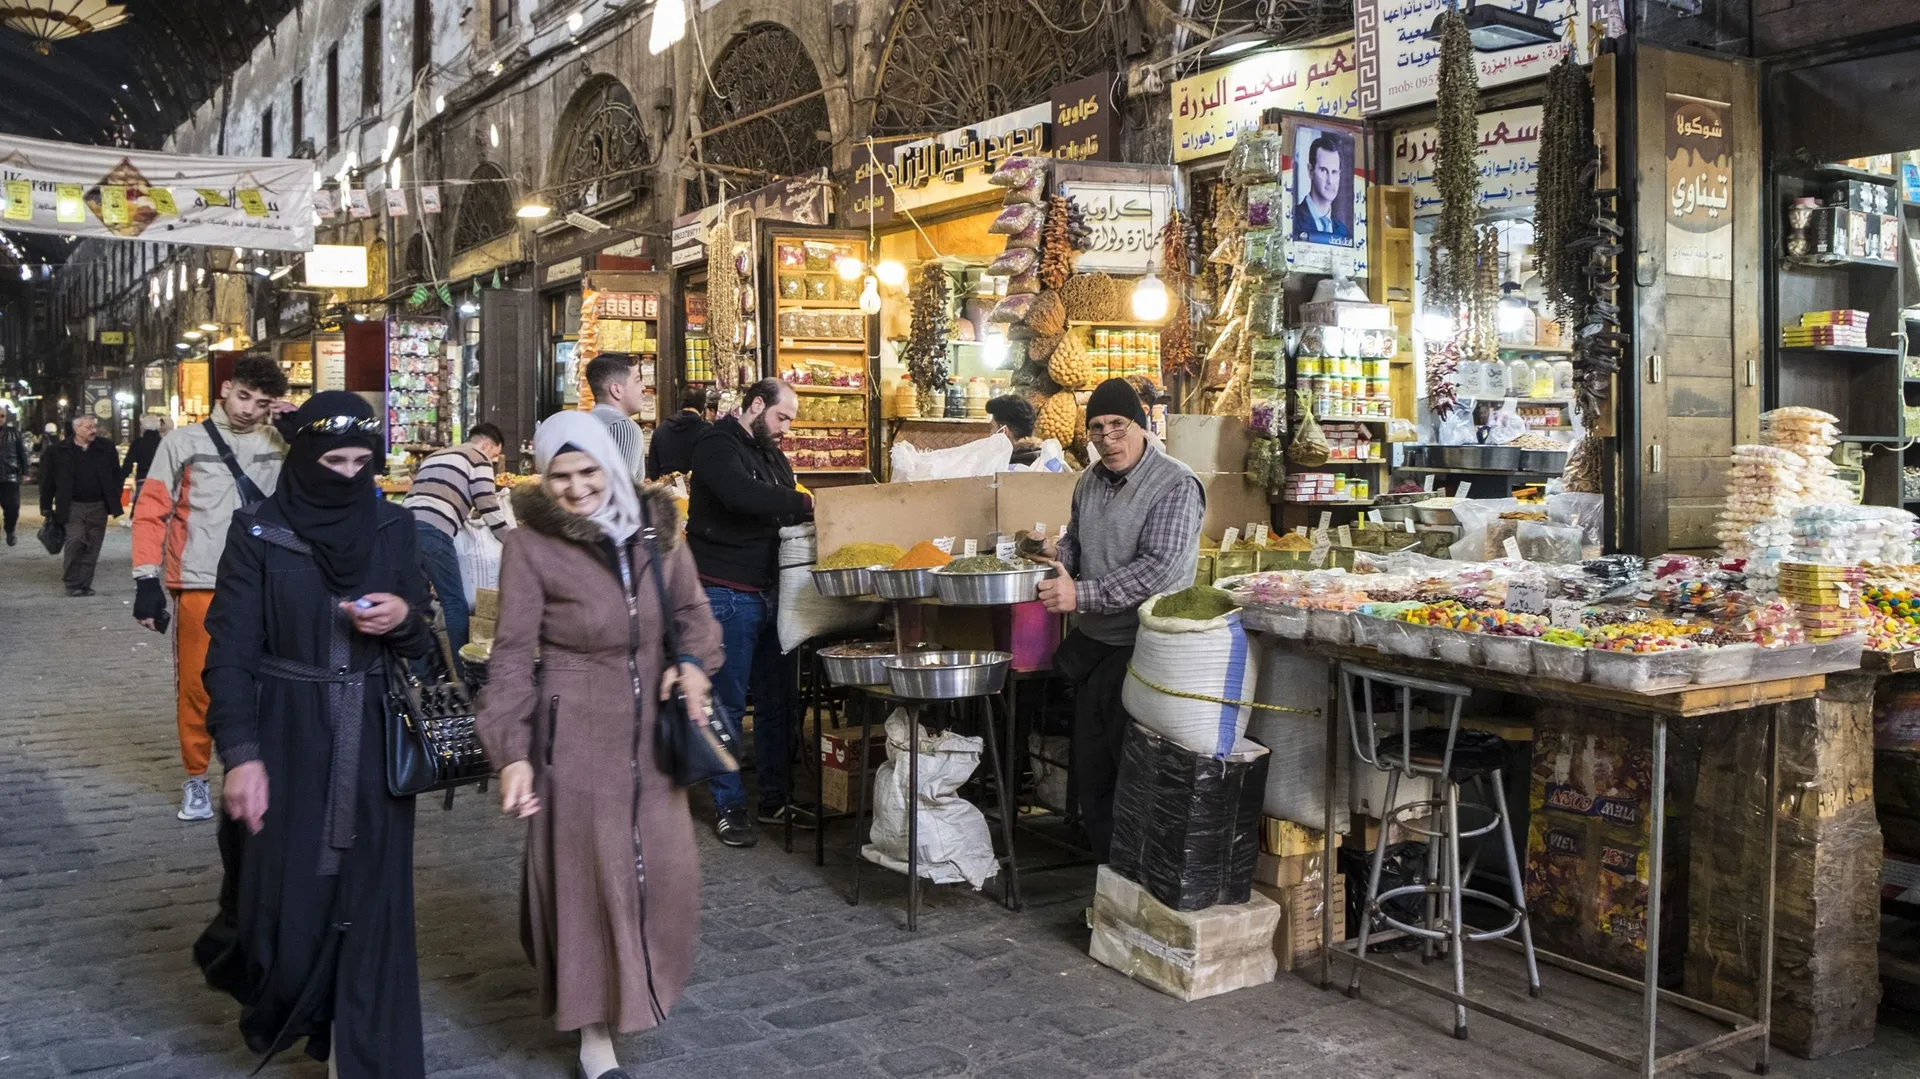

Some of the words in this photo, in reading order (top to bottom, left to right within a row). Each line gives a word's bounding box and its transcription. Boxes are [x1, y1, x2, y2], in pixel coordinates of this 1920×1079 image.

[1305, 43, 1357, 91] نعيم
[1480, 56, 1512, 75] البزرة
[1514, 52, 1540, 69] سعيد
[1180, 77, 1227, 120] البزرة
[1233, 71, 1297, 105] سعيد
[1388, 80, 1414, 95] mob:
[1058, 94, 1099, 126] كراوية
[1677, 115, 1723, 139] شوكولا
[988, 122, 1046, 160] محمد
[1181, 124, 1217, 150] زهورات
[1477, 121, 1539, 155] سعي
[886, 143, 937, 189] الزراد
[938, 128, 989, 183] بشير
[1672, 172, 1728, 217] تيناوي
[1601, 802, 1635, 821] VIEW
